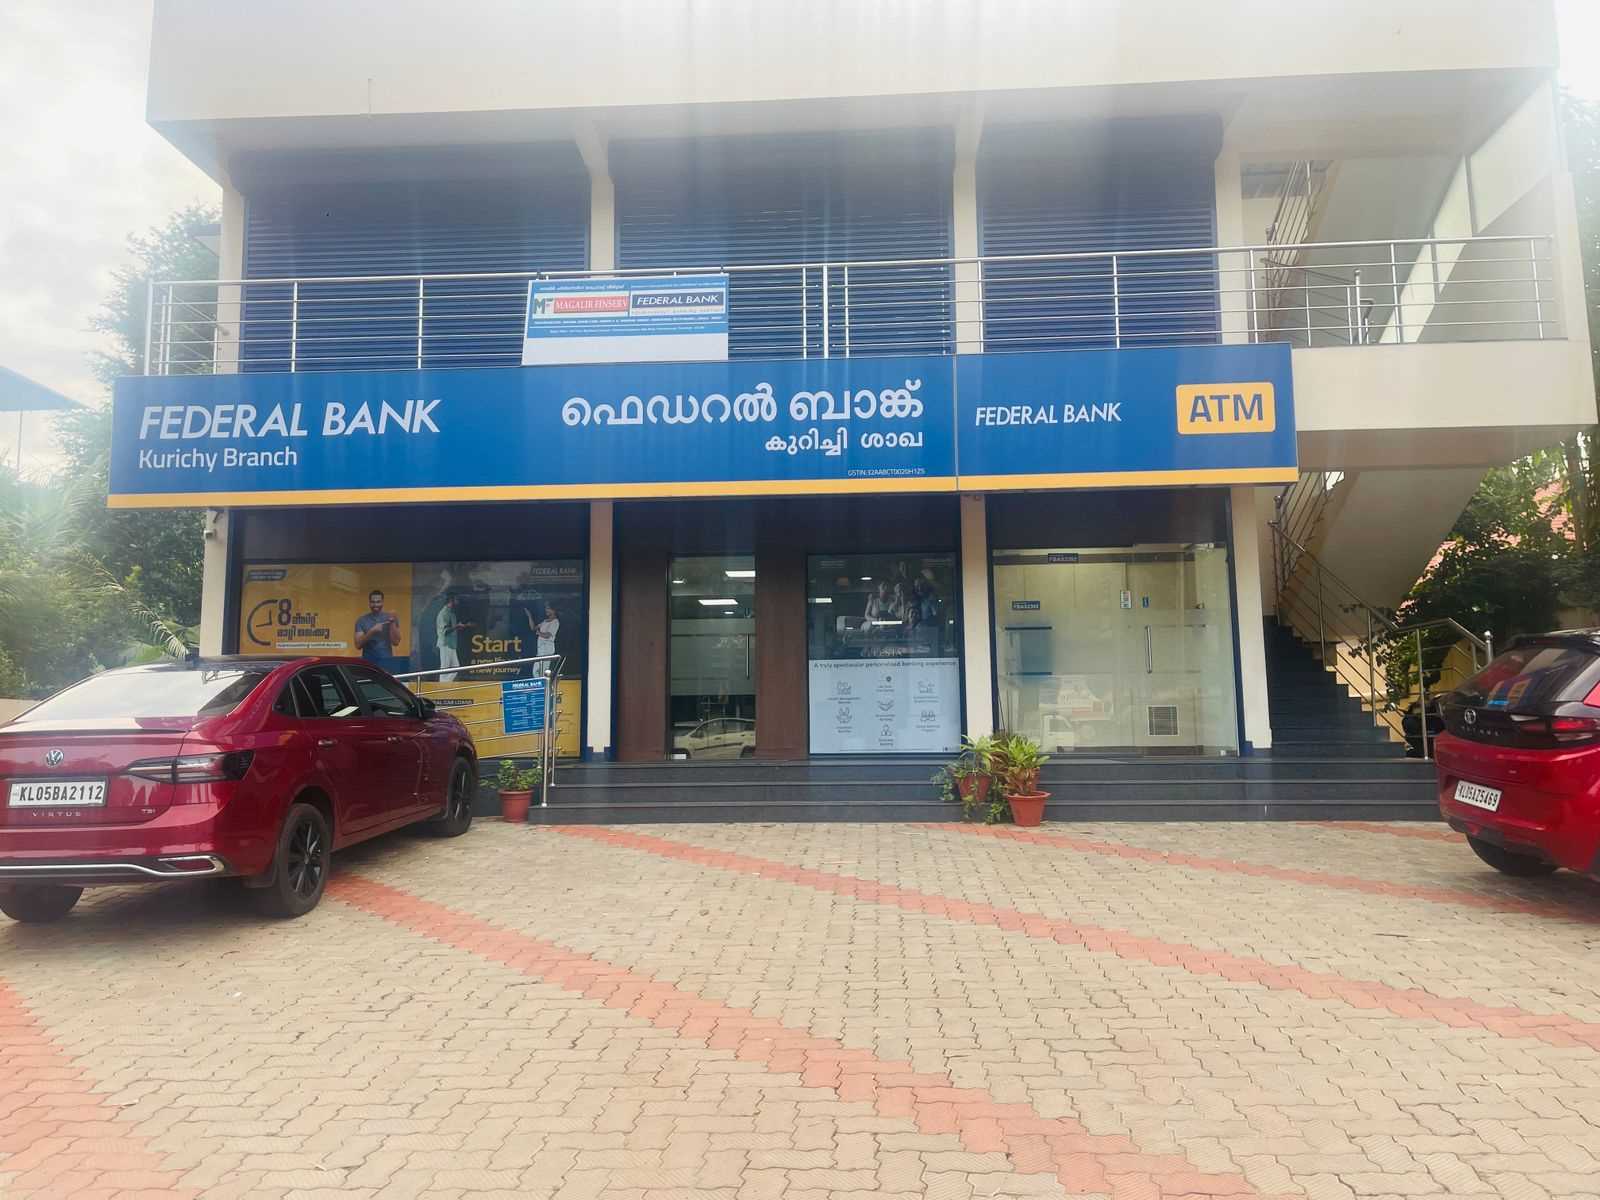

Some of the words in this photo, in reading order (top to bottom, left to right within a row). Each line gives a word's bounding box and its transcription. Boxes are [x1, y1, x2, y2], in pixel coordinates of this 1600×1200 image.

[637, 295, 683, 305] FEDERAL
[686, 294, 719, 304] BANK
[562, 382, 777, 426] ഫെഡറൽ
[789, 378, 924, 422] ബാങ്ക്
[976, 405, 1058, 426] FEDERAL
[1063, 402, 1122, 424] BANK
[1189, 393, 1264, 423] ATM
[139, 402, 308, 440] FEDERAL
[322, 399, 441, 436] BANK
[765, 427, 848, 456] കുറിച്ചി
[861, 431, 924, 450] ശാഖ
[139, 449, 218, 473] Kurichy
[224, 446, 297, 467] Branch
[278, 598, 291, 625] 8
[471, 634, 522, 653] Start
[19, 784, 104, 802] KL05BA2112
